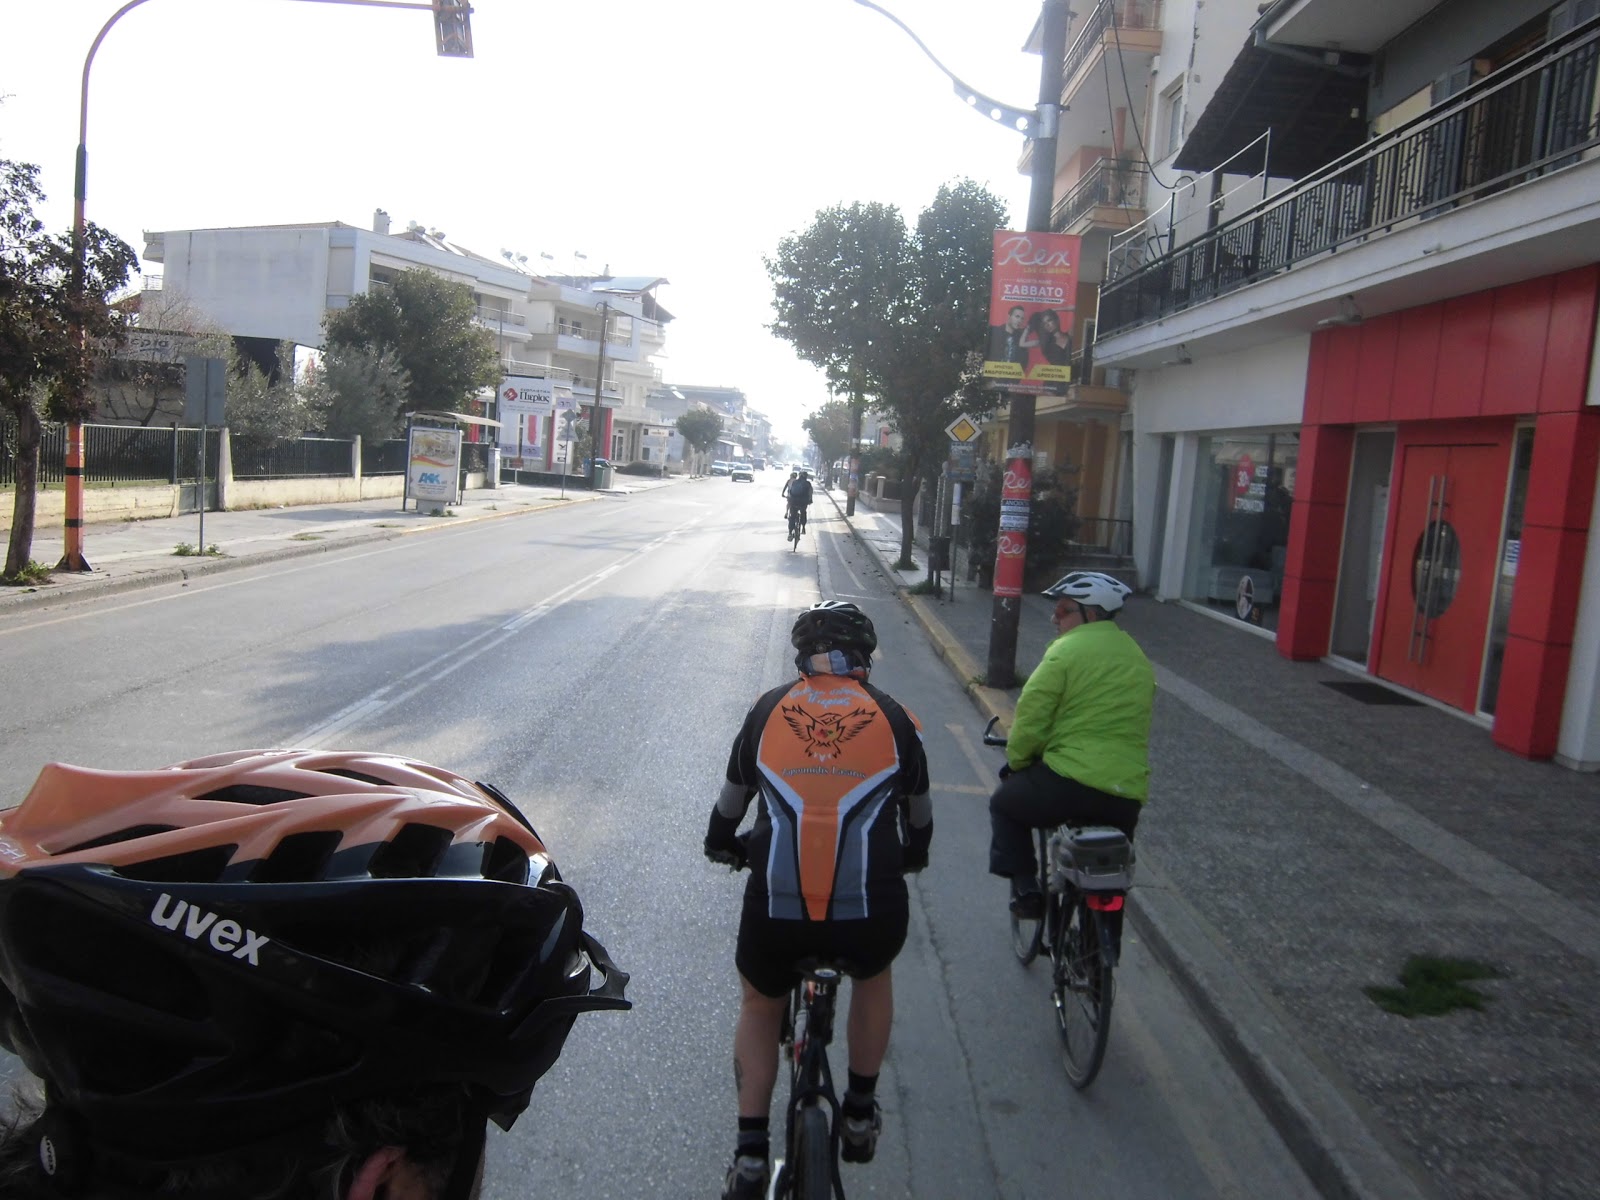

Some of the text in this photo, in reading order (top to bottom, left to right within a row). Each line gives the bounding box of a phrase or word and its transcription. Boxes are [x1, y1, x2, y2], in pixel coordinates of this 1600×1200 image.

[998, 236, 1070, 266] Rex
[1004, 284, 1063, 297] ΣΑΒΒΑΤΟ
[151, 892, 270, 967] uvex
